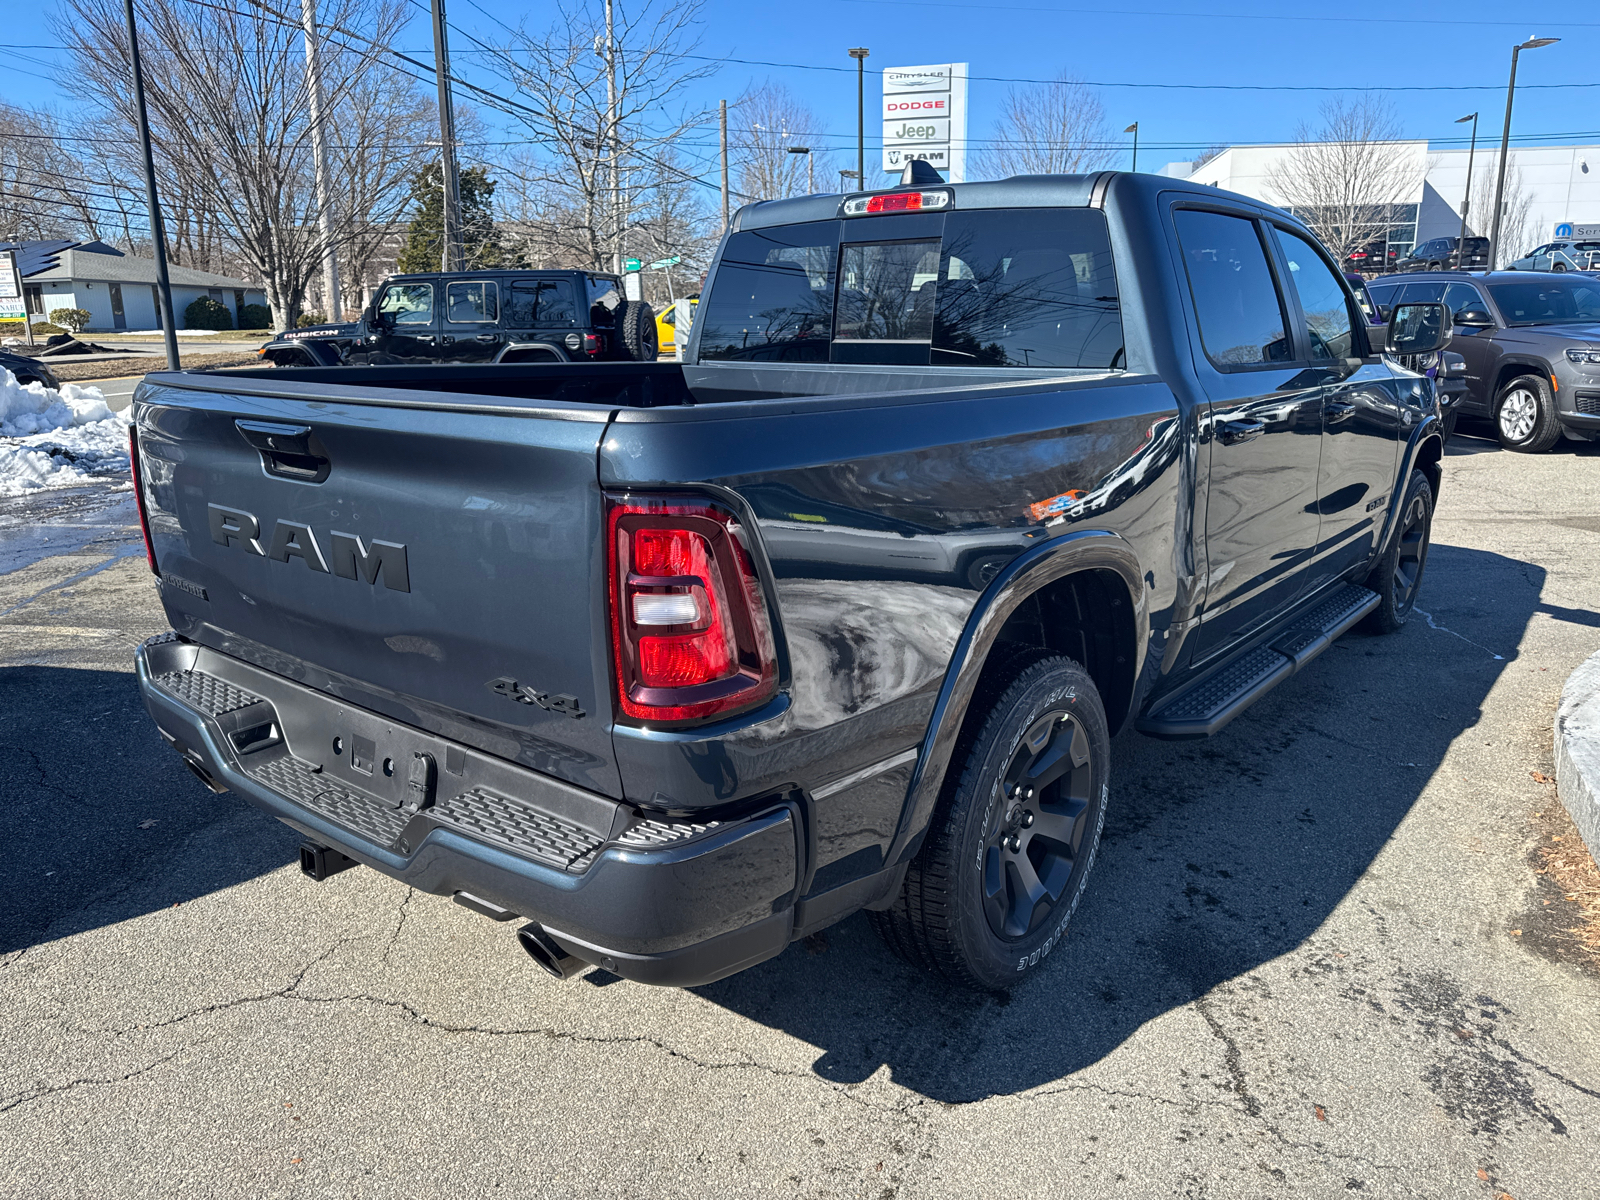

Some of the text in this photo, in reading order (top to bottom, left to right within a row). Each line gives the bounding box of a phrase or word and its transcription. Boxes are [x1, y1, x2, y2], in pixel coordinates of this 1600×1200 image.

[889, 72, 944, 80] CHRYSLER
[887, 101, 945, 111] DODGE
[896, 123, 936, 139] Jeep
[904, 152, 944, 161] RAM
[1577, 227, 1600, 236] Ser
[284, 329, 339, 339] RUBICON
[208, 502, 411, 593] RAM
[1016, 783, 1110, 972] BRIDGESTONE
